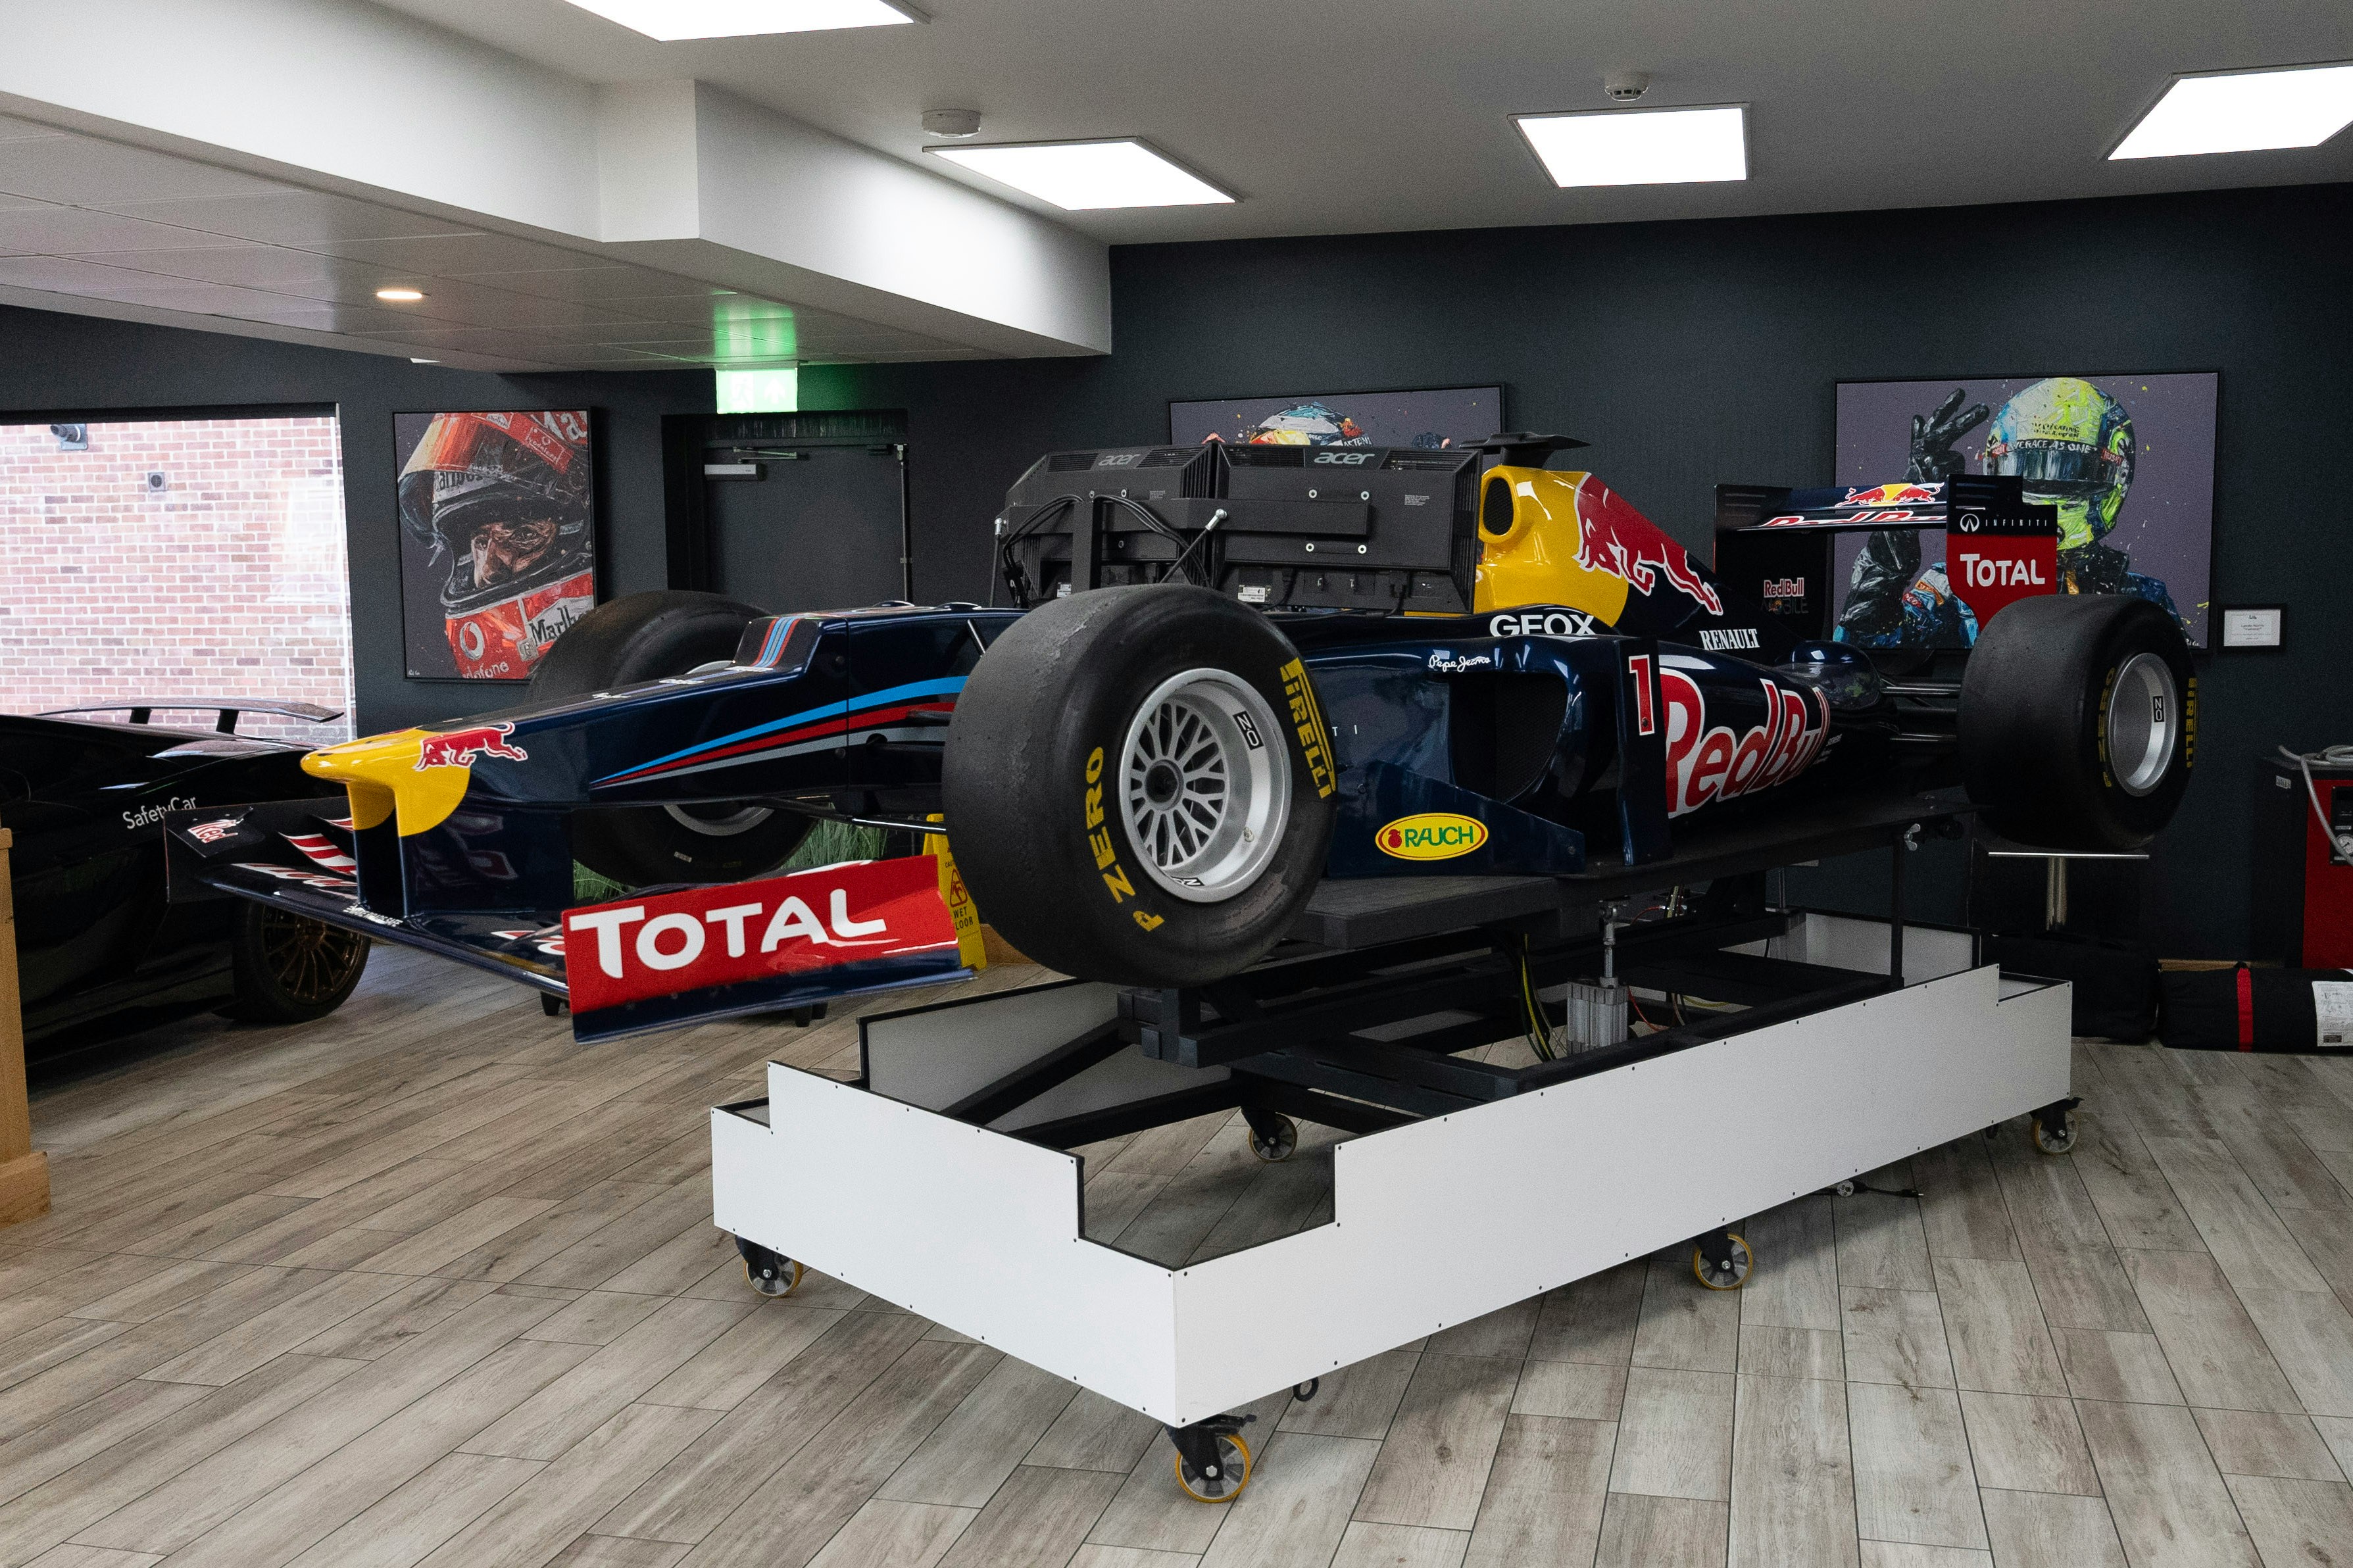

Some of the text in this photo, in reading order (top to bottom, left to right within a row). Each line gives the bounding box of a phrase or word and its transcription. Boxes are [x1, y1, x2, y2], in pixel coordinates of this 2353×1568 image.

[1098, 453, 1141, 466] acer
[1314, 452, 1375, 464] acer
[1960, 553, 2046, 587] TOTAL
[1764, 577, 1804, 598] Red Bull
[1699, 628, 1760, 650] RENAULT
[1428, 654, 1457, 672] Pepe
[1629, 654, 1655, 736] 1
[1280, 657, 1337, 799] PIRELLI
[1085, 747, 1165, 932] P ZERO
[1404, 825, 1474, 848] RAUCH
[953, 906, 967, 919] WET
[954, 916, 974, 931] LOOR
[570, 889, 887, 979] TOTAL
